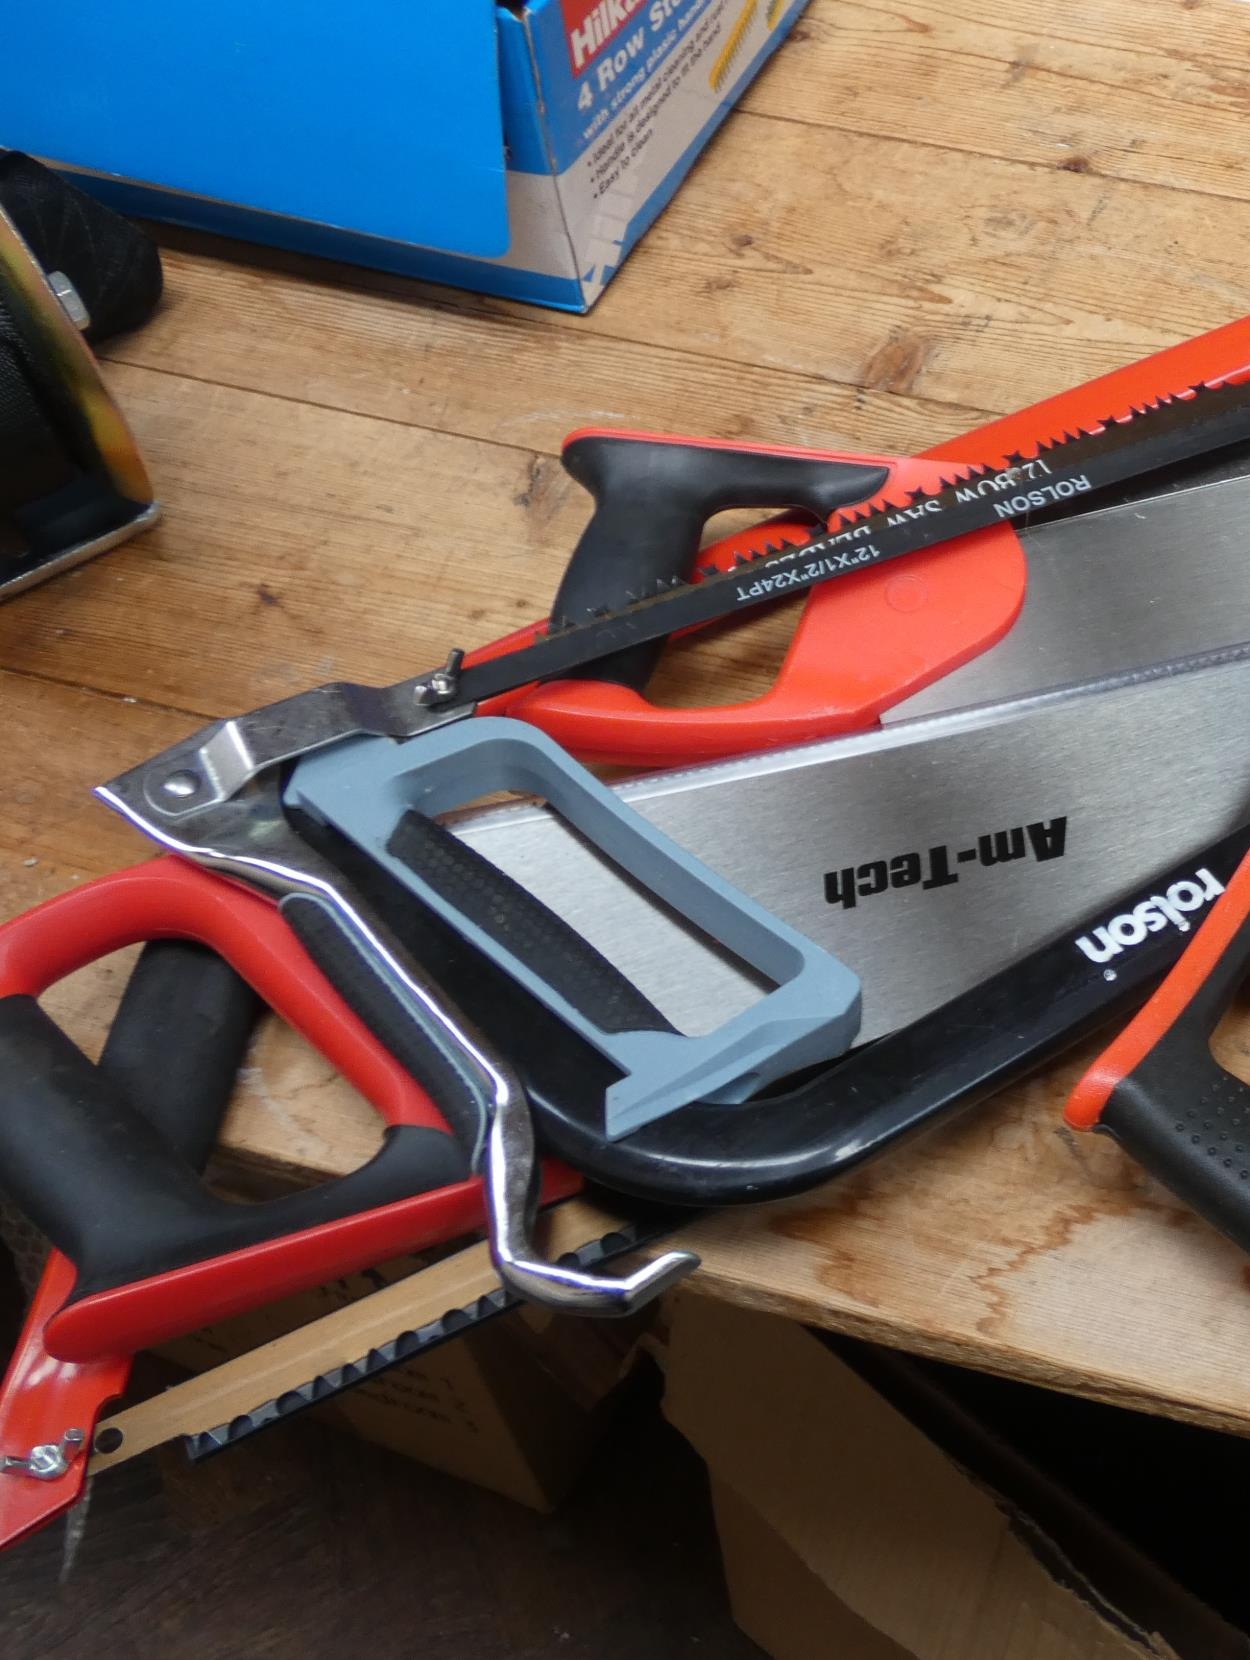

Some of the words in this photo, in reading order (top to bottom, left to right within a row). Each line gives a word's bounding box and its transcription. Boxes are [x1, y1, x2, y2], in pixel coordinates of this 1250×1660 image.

[577, 80, 594, 111] 4
[597, 27, 645, 91] Row
[583, 108, 609, 139] with
[611, 67, 646, 110] strong
[646, 29, 678, 73] plastic
[615, 121, 627, 138] for
[599, 167, 619, 195] Easy
[993, 475, 1091, 518] ROLSON
[737, 545, 880, 601] 12"X1/2"X24PT
[823, 816, 1068, 909] Am-Tech
[1075, 867, 1226, 963] rolson
